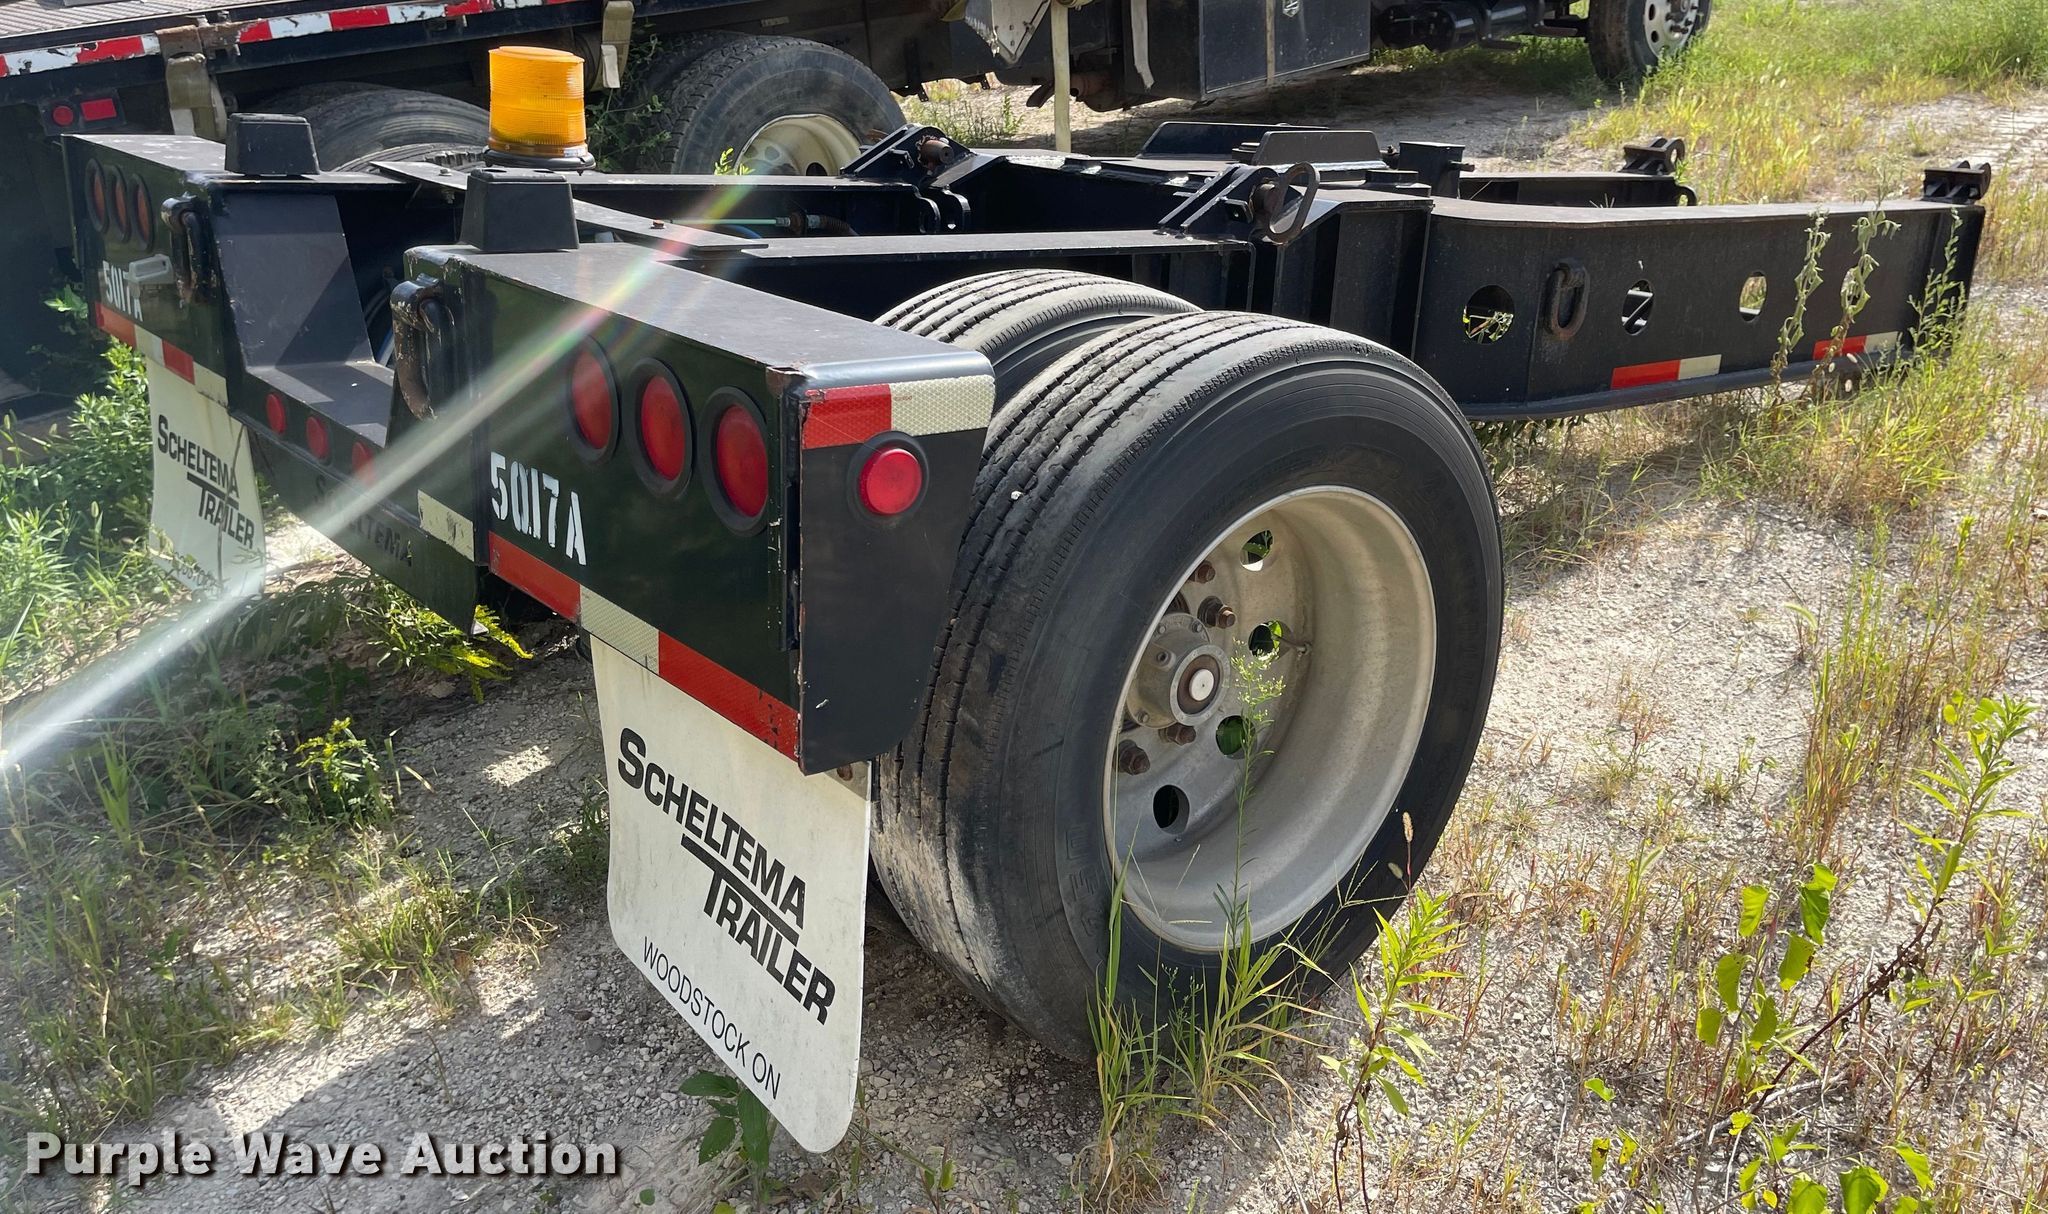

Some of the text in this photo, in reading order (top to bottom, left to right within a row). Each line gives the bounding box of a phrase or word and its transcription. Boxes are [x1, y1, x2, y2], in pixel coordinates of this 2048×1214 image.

[157, 414, 240, 498] SCHELTEMA
[187, 472, 255, 550] TRAILER
[490, 451, 587, 566] 5017A
[313, 474, 414, 562] SLTEMA
[617, 727, 806, 930] SCHELTEMA
[681, 833, 836, 1026] TRAILER
[643, 935, 781, 1100] WOODSTOCK ON
